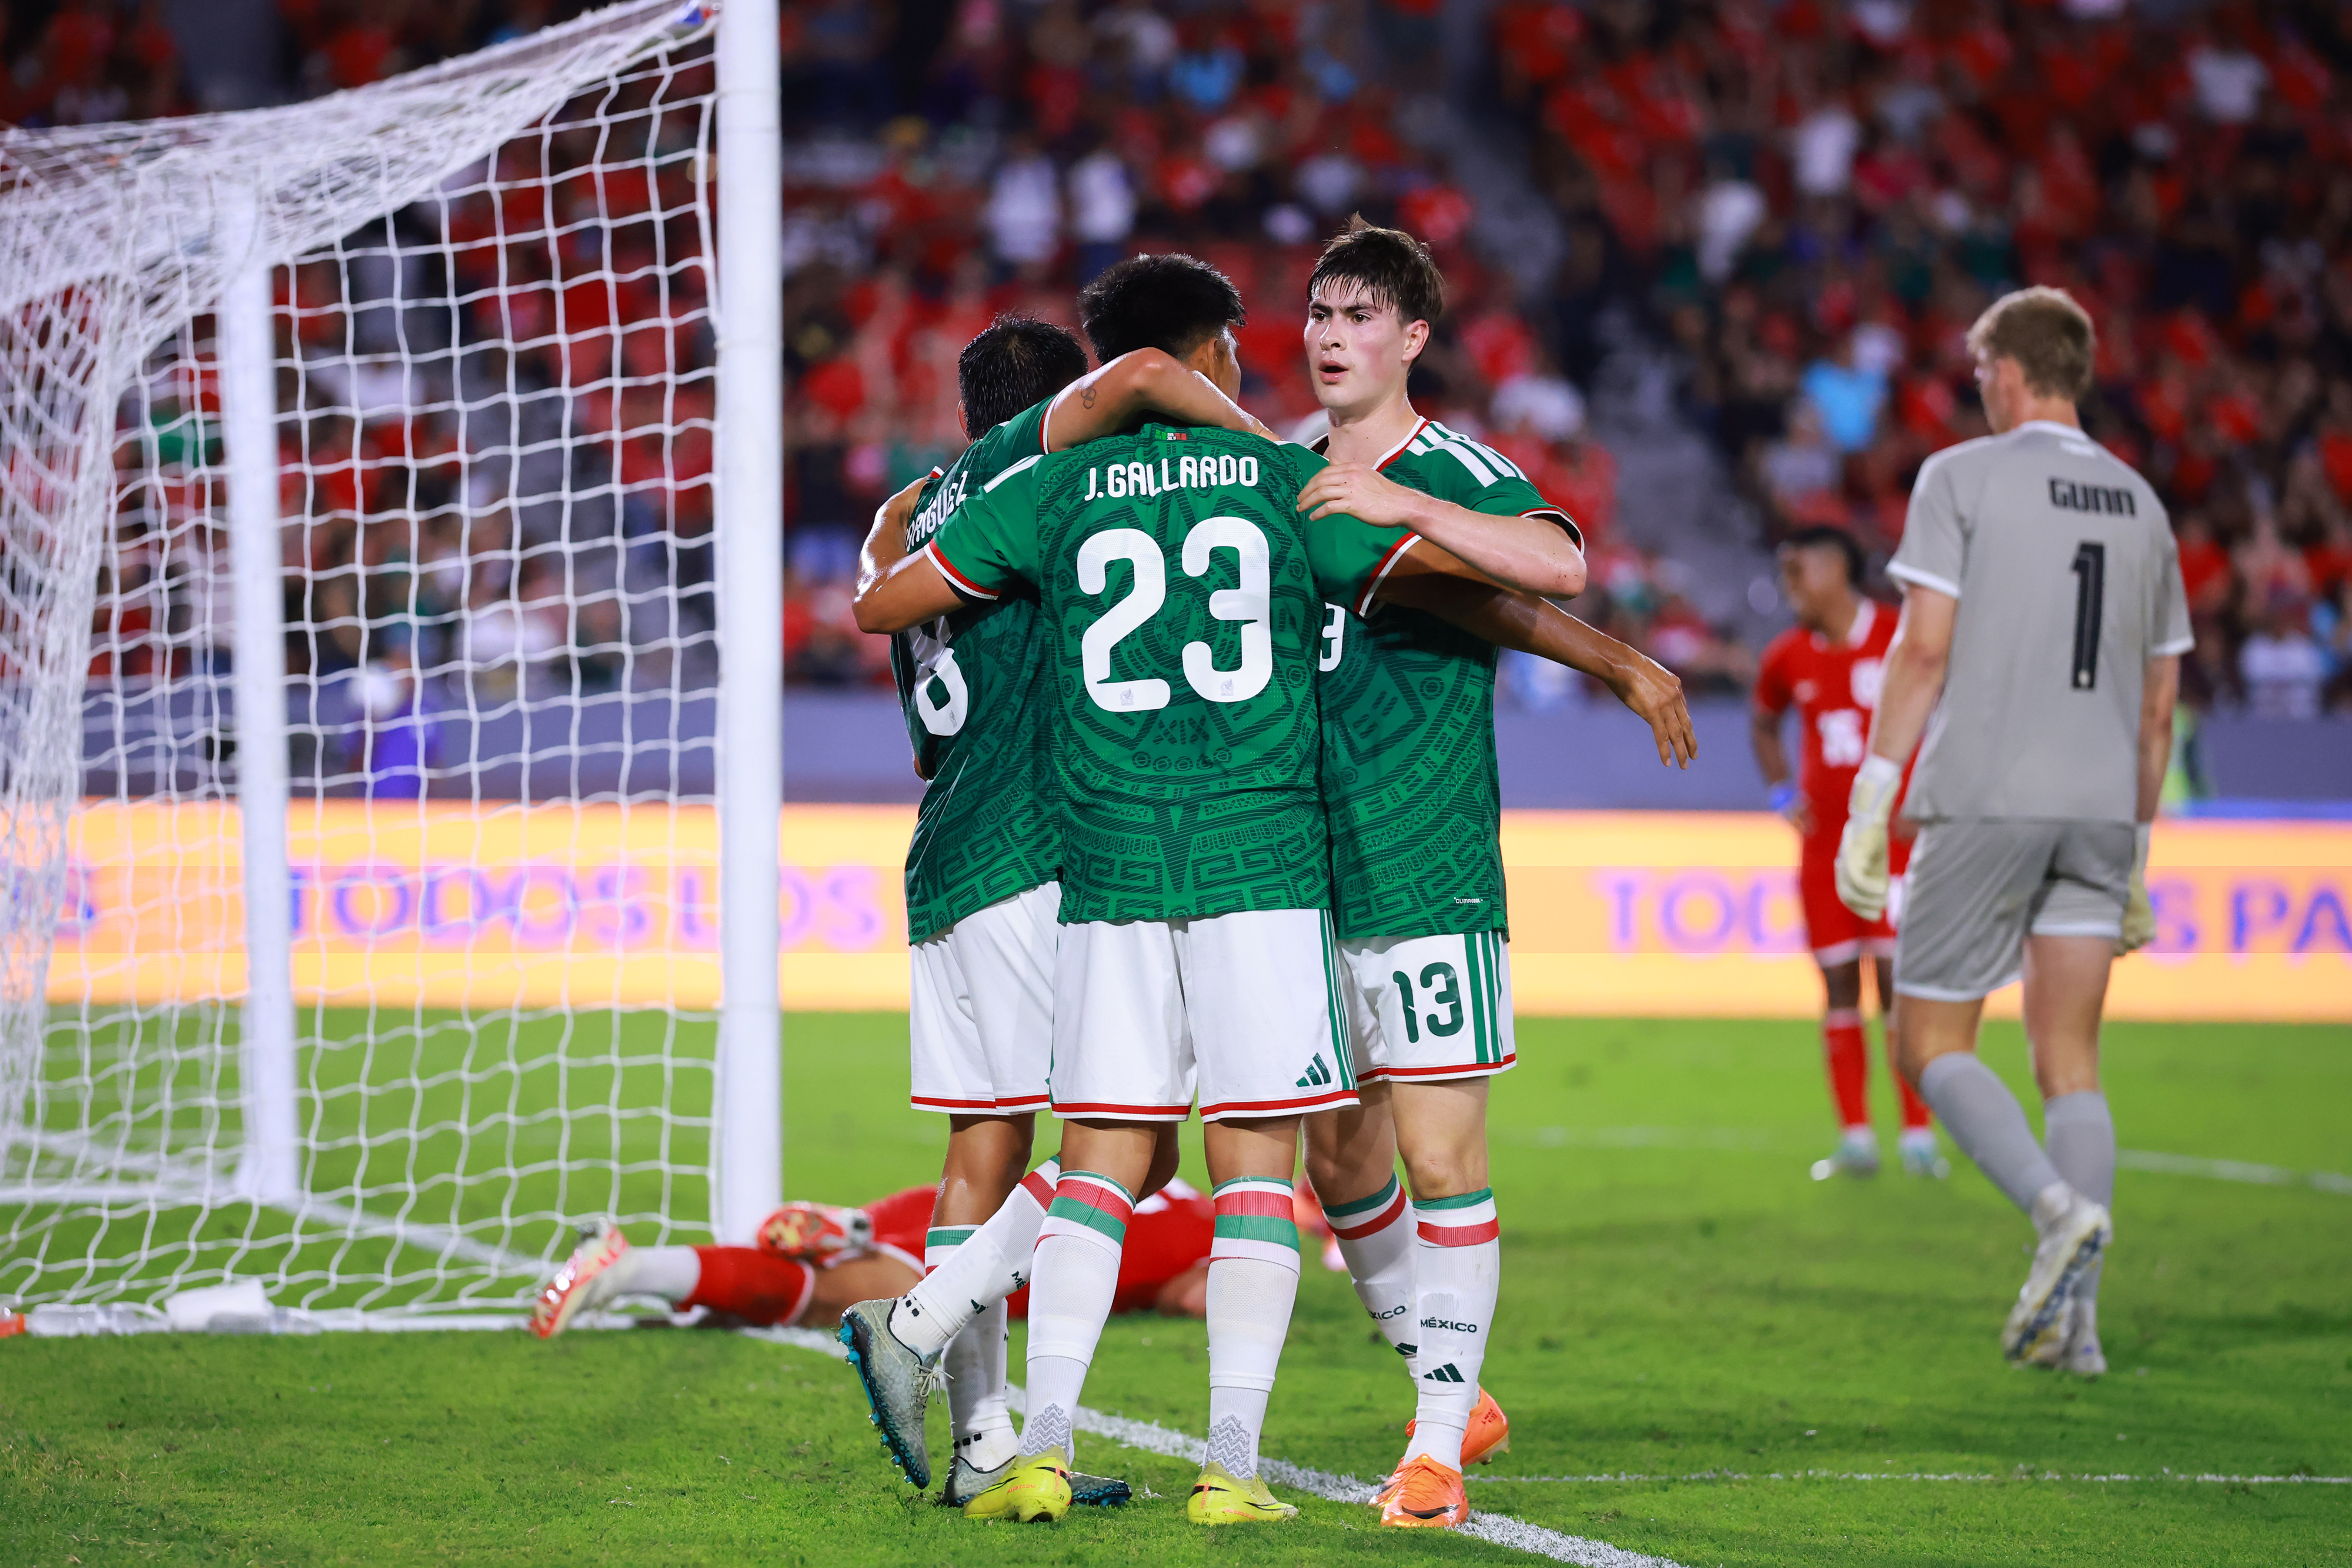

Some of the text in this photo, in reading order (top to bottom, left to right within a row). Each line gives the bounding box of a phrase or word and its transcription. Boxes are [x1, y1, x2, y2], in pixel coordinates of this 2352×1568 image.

[1084, 454, 1258, 502] J.GALLARDO
[1077, 516, 1273, 713] 23
[2071, 542, 2104, 689] 1
[1392, 962, 1464, 1044] 13
[1366, 1305, 1406, 1320] XICO
[1420, 1317, 1477, 1333] MÉXICO
